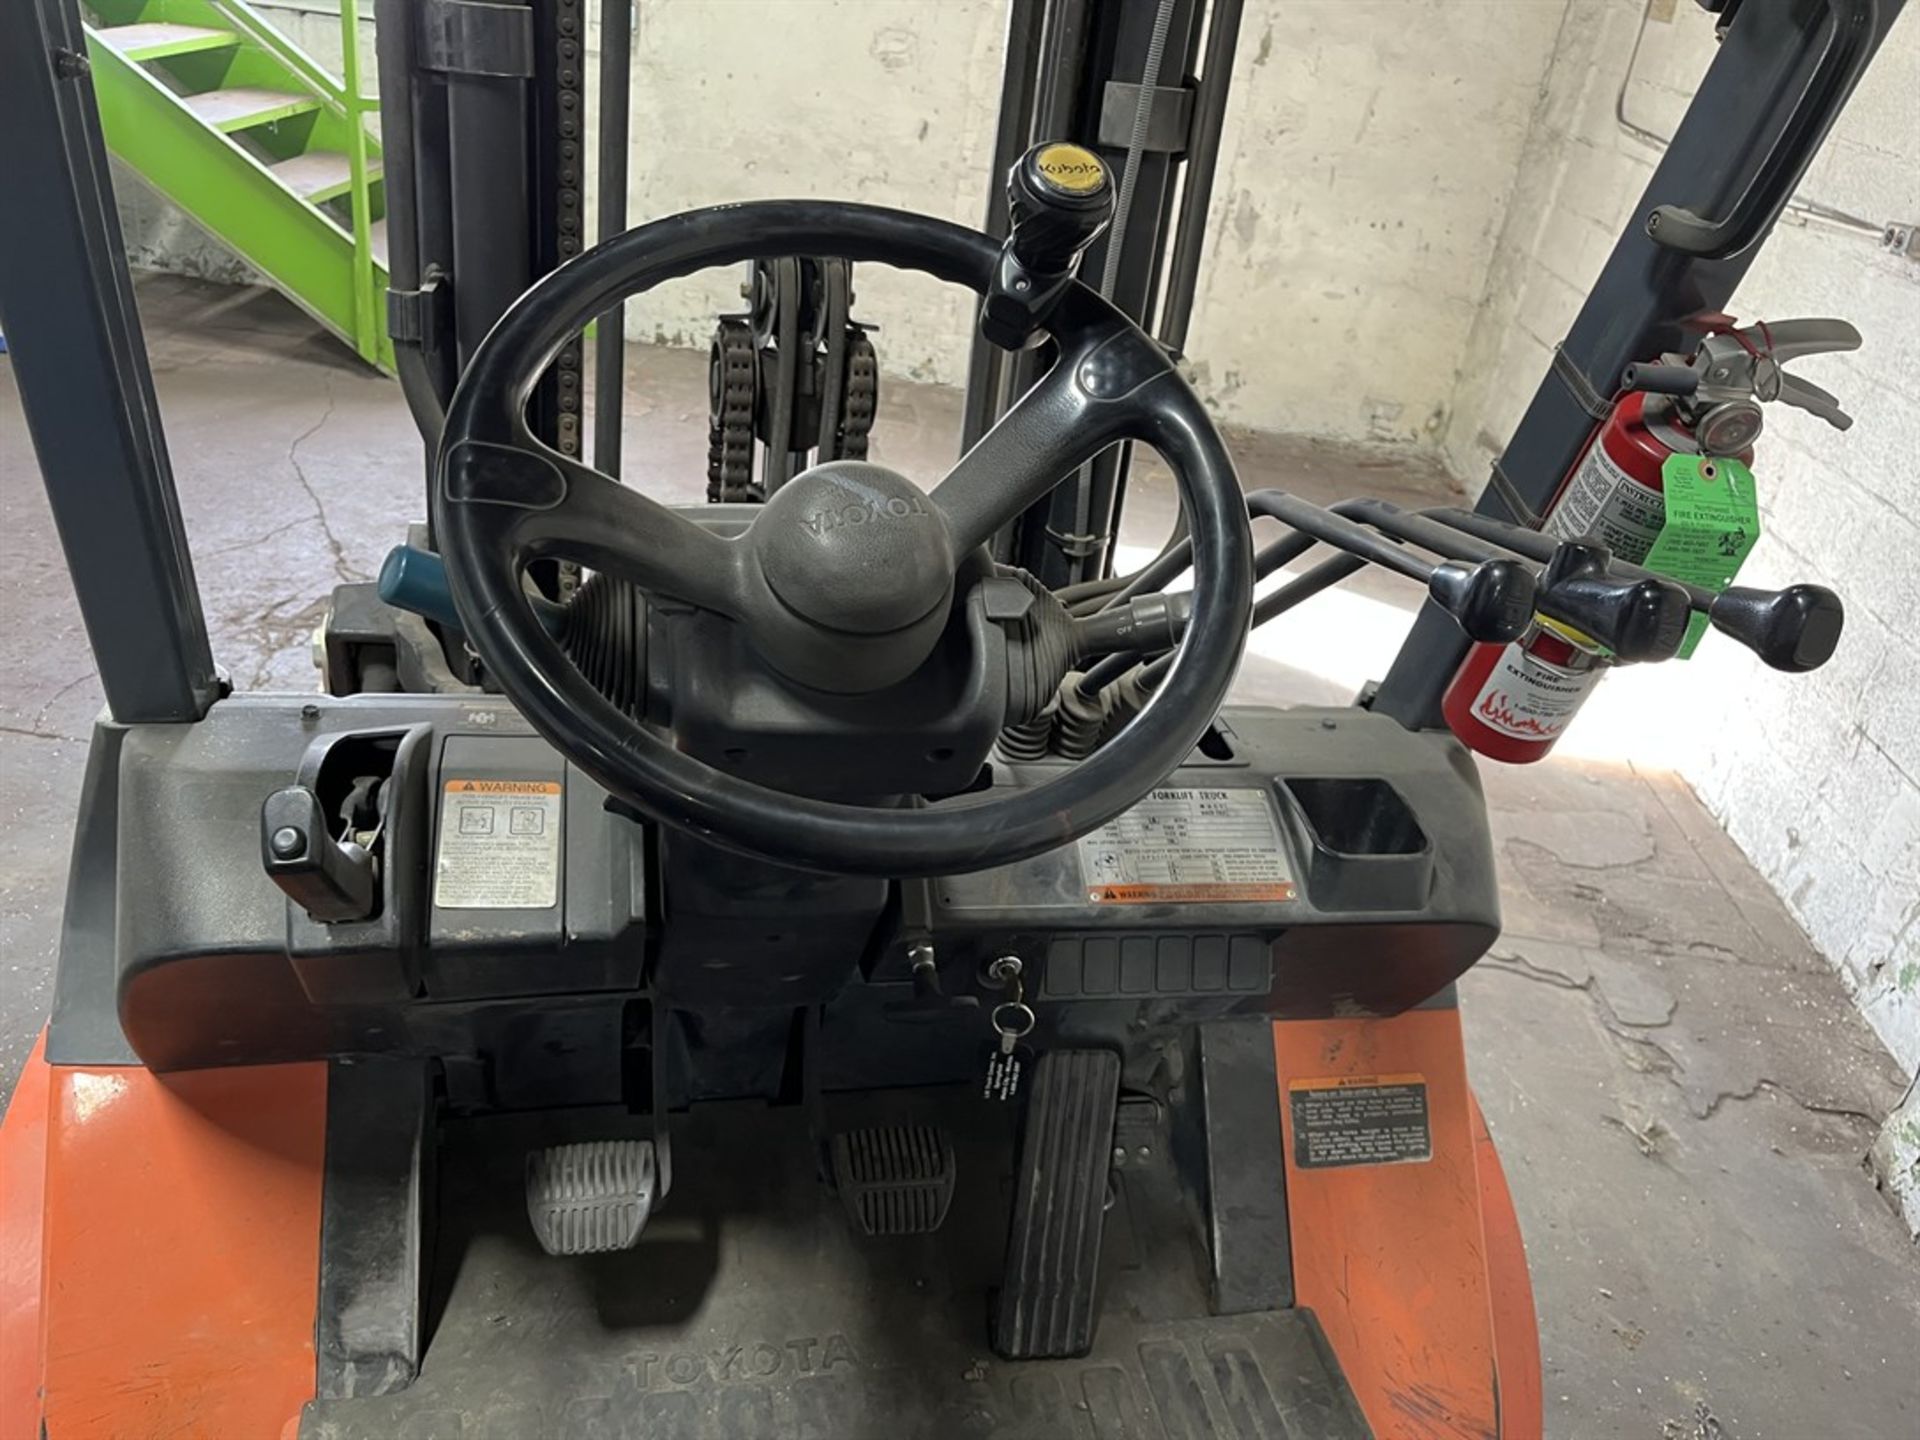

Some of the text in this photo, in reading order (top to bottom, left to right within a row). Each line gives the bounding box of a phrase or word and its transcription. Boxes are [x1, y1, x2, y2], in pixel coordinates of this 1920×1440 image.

[1038, 162, 1101, 174] Kubota
[799, 496, 929, 542] TOYOTA
[1674, 510, 1751, 524] FIRE EXTINGUISHER
[1506, 664, 1582, 693] EXTINGUISHER
[1535, 671, 1561, 684] FIRE
[479, 782, 547, 793] WARNING
[1152, 791, 1228, 800] FORKLIFT TRUCK
[624, 1333, 859, 1388] TOYOTA
